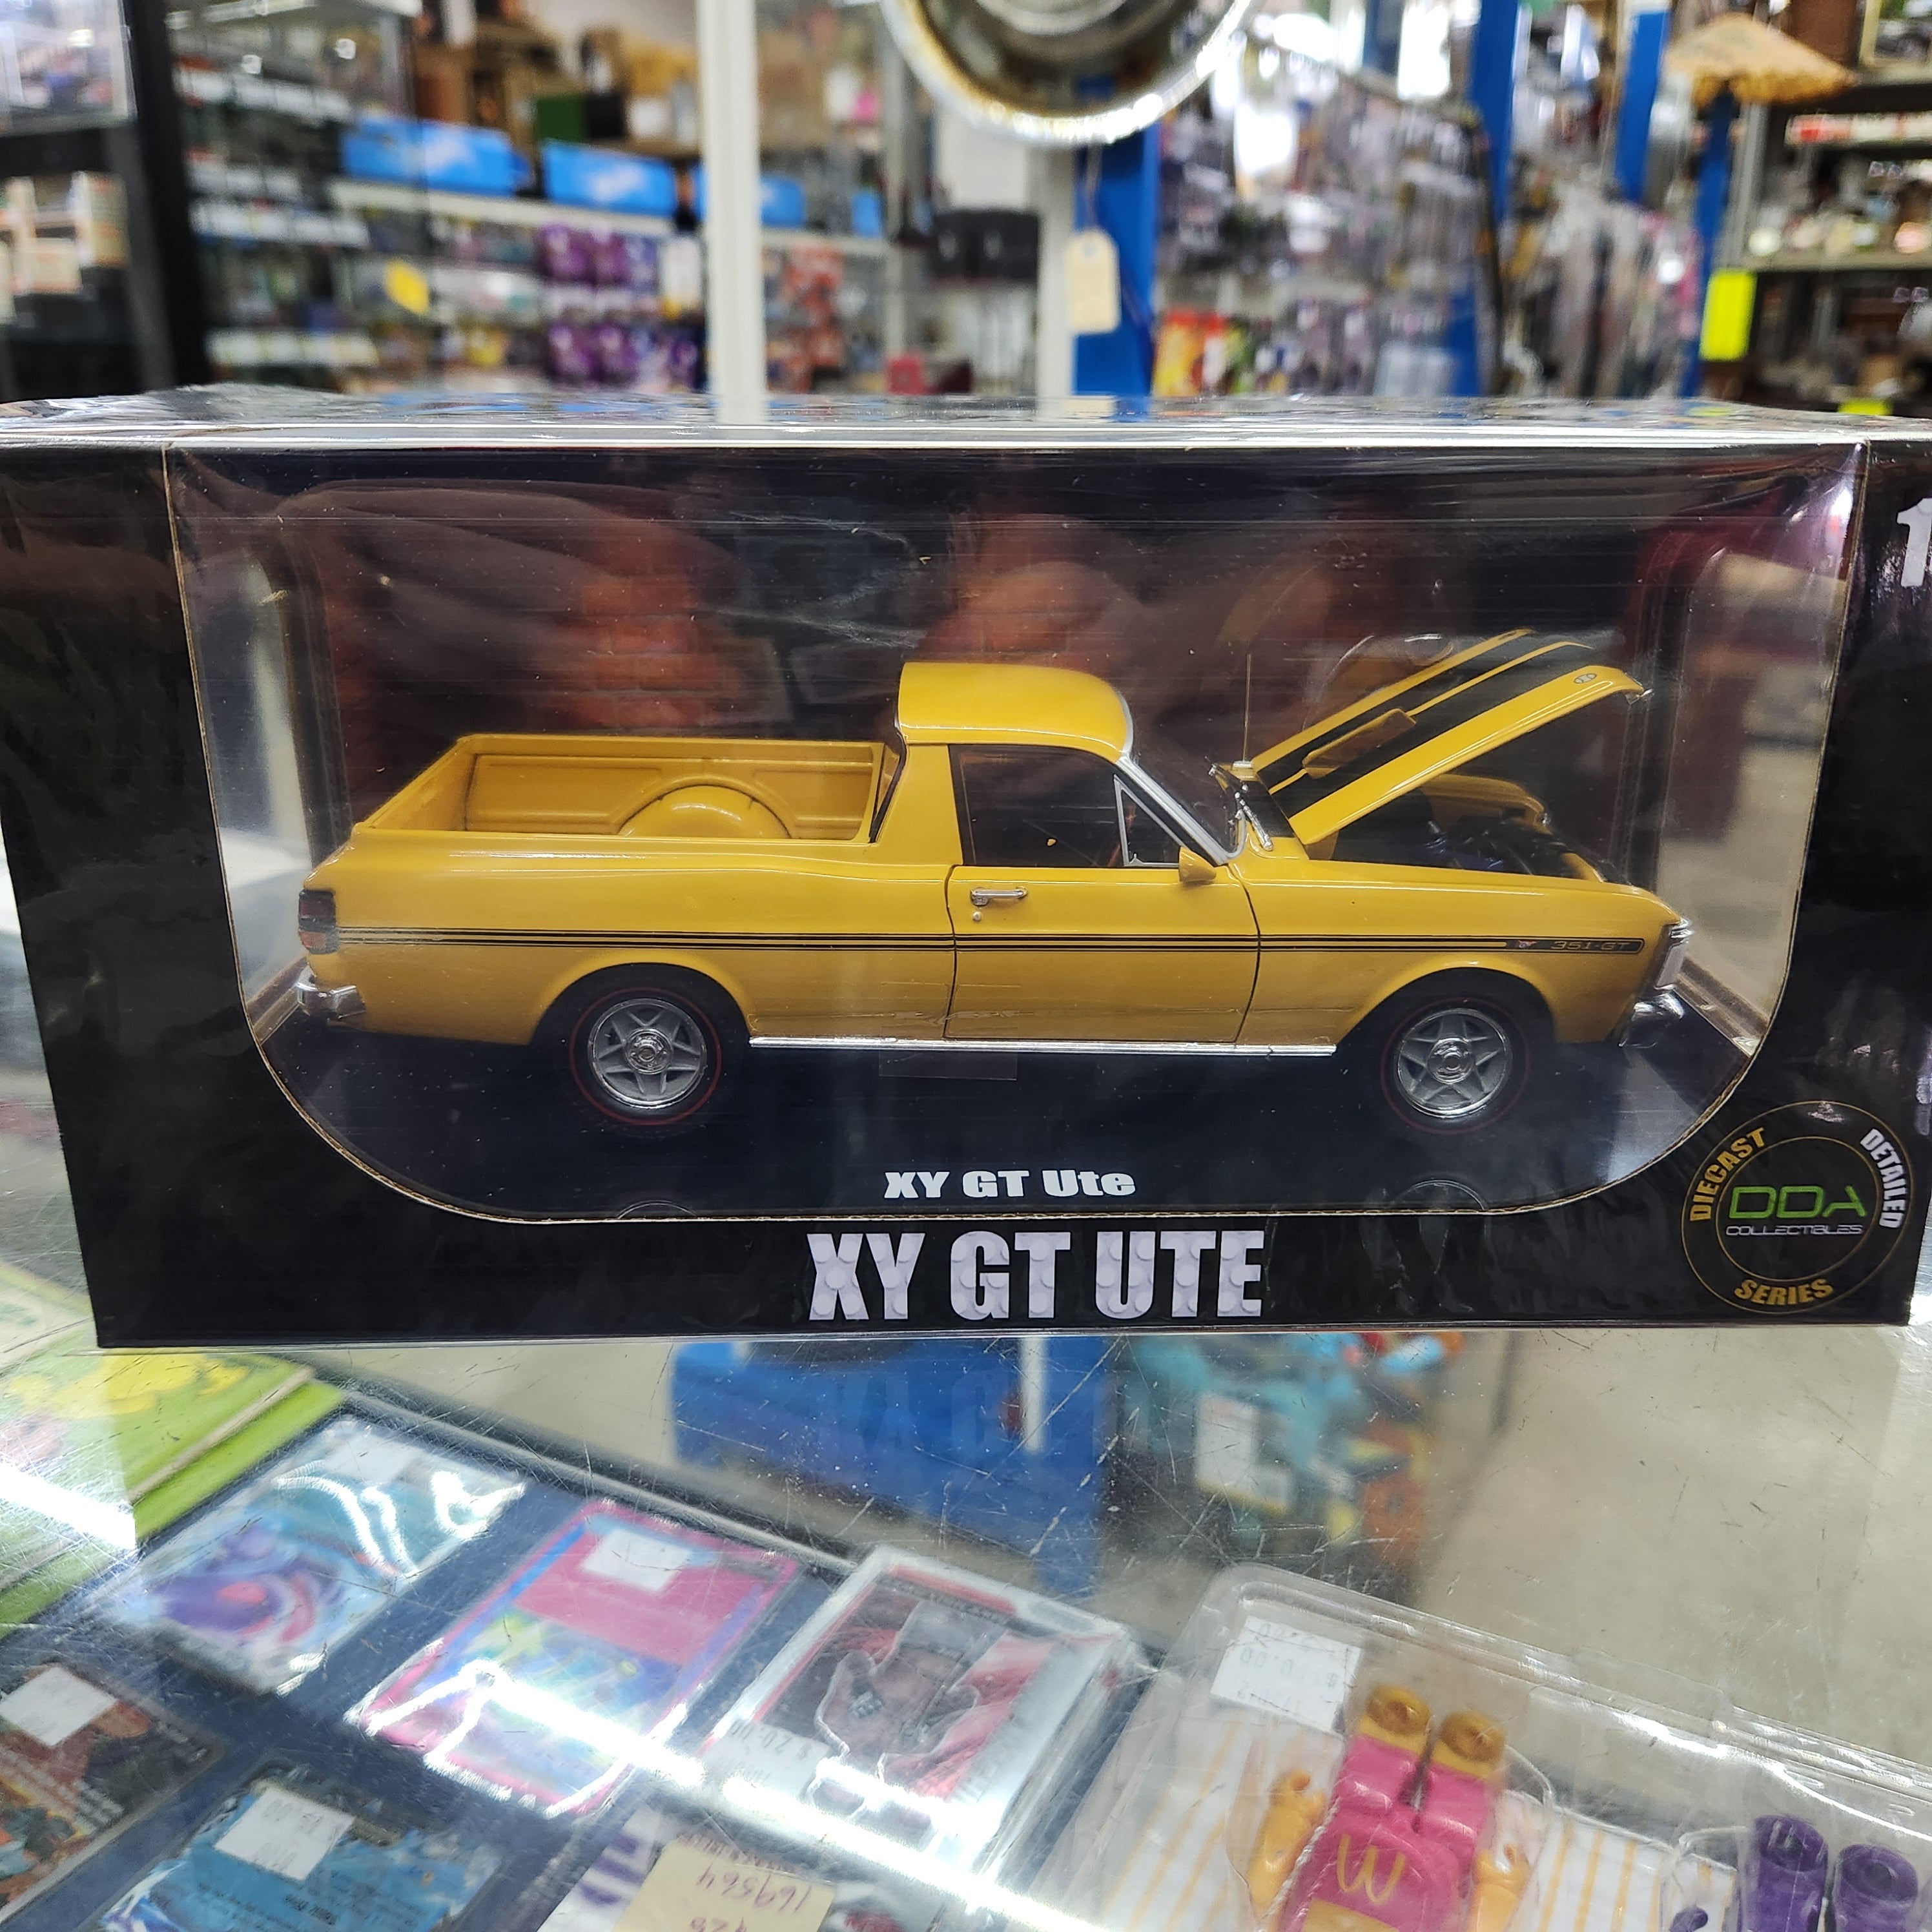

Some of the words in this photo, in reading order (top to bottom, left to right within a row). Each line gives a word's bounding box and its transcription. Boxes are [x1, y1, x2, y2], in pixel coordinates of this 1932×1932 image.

[883, 1171, 951, 1199] XY
[961, 1169, 1031, 1198] GT
[1042, 1169, 1136, 1197] Ute
[1689, 1127, 1765, 1222] DIECAST
[1859, 1127, 1908, 1229] DETAILED
[1729, 1185, 1867, 1219] DDA
[1725, 1224, 1864, 1237] COLLECTIBLES
[806, 1231, 926, 1321] XY
[949, 1229, 1072, 1321] GT
[1094, 1229, 1266, 1320] UTE
[1733, 1278, 1834, 1306] SERIES
